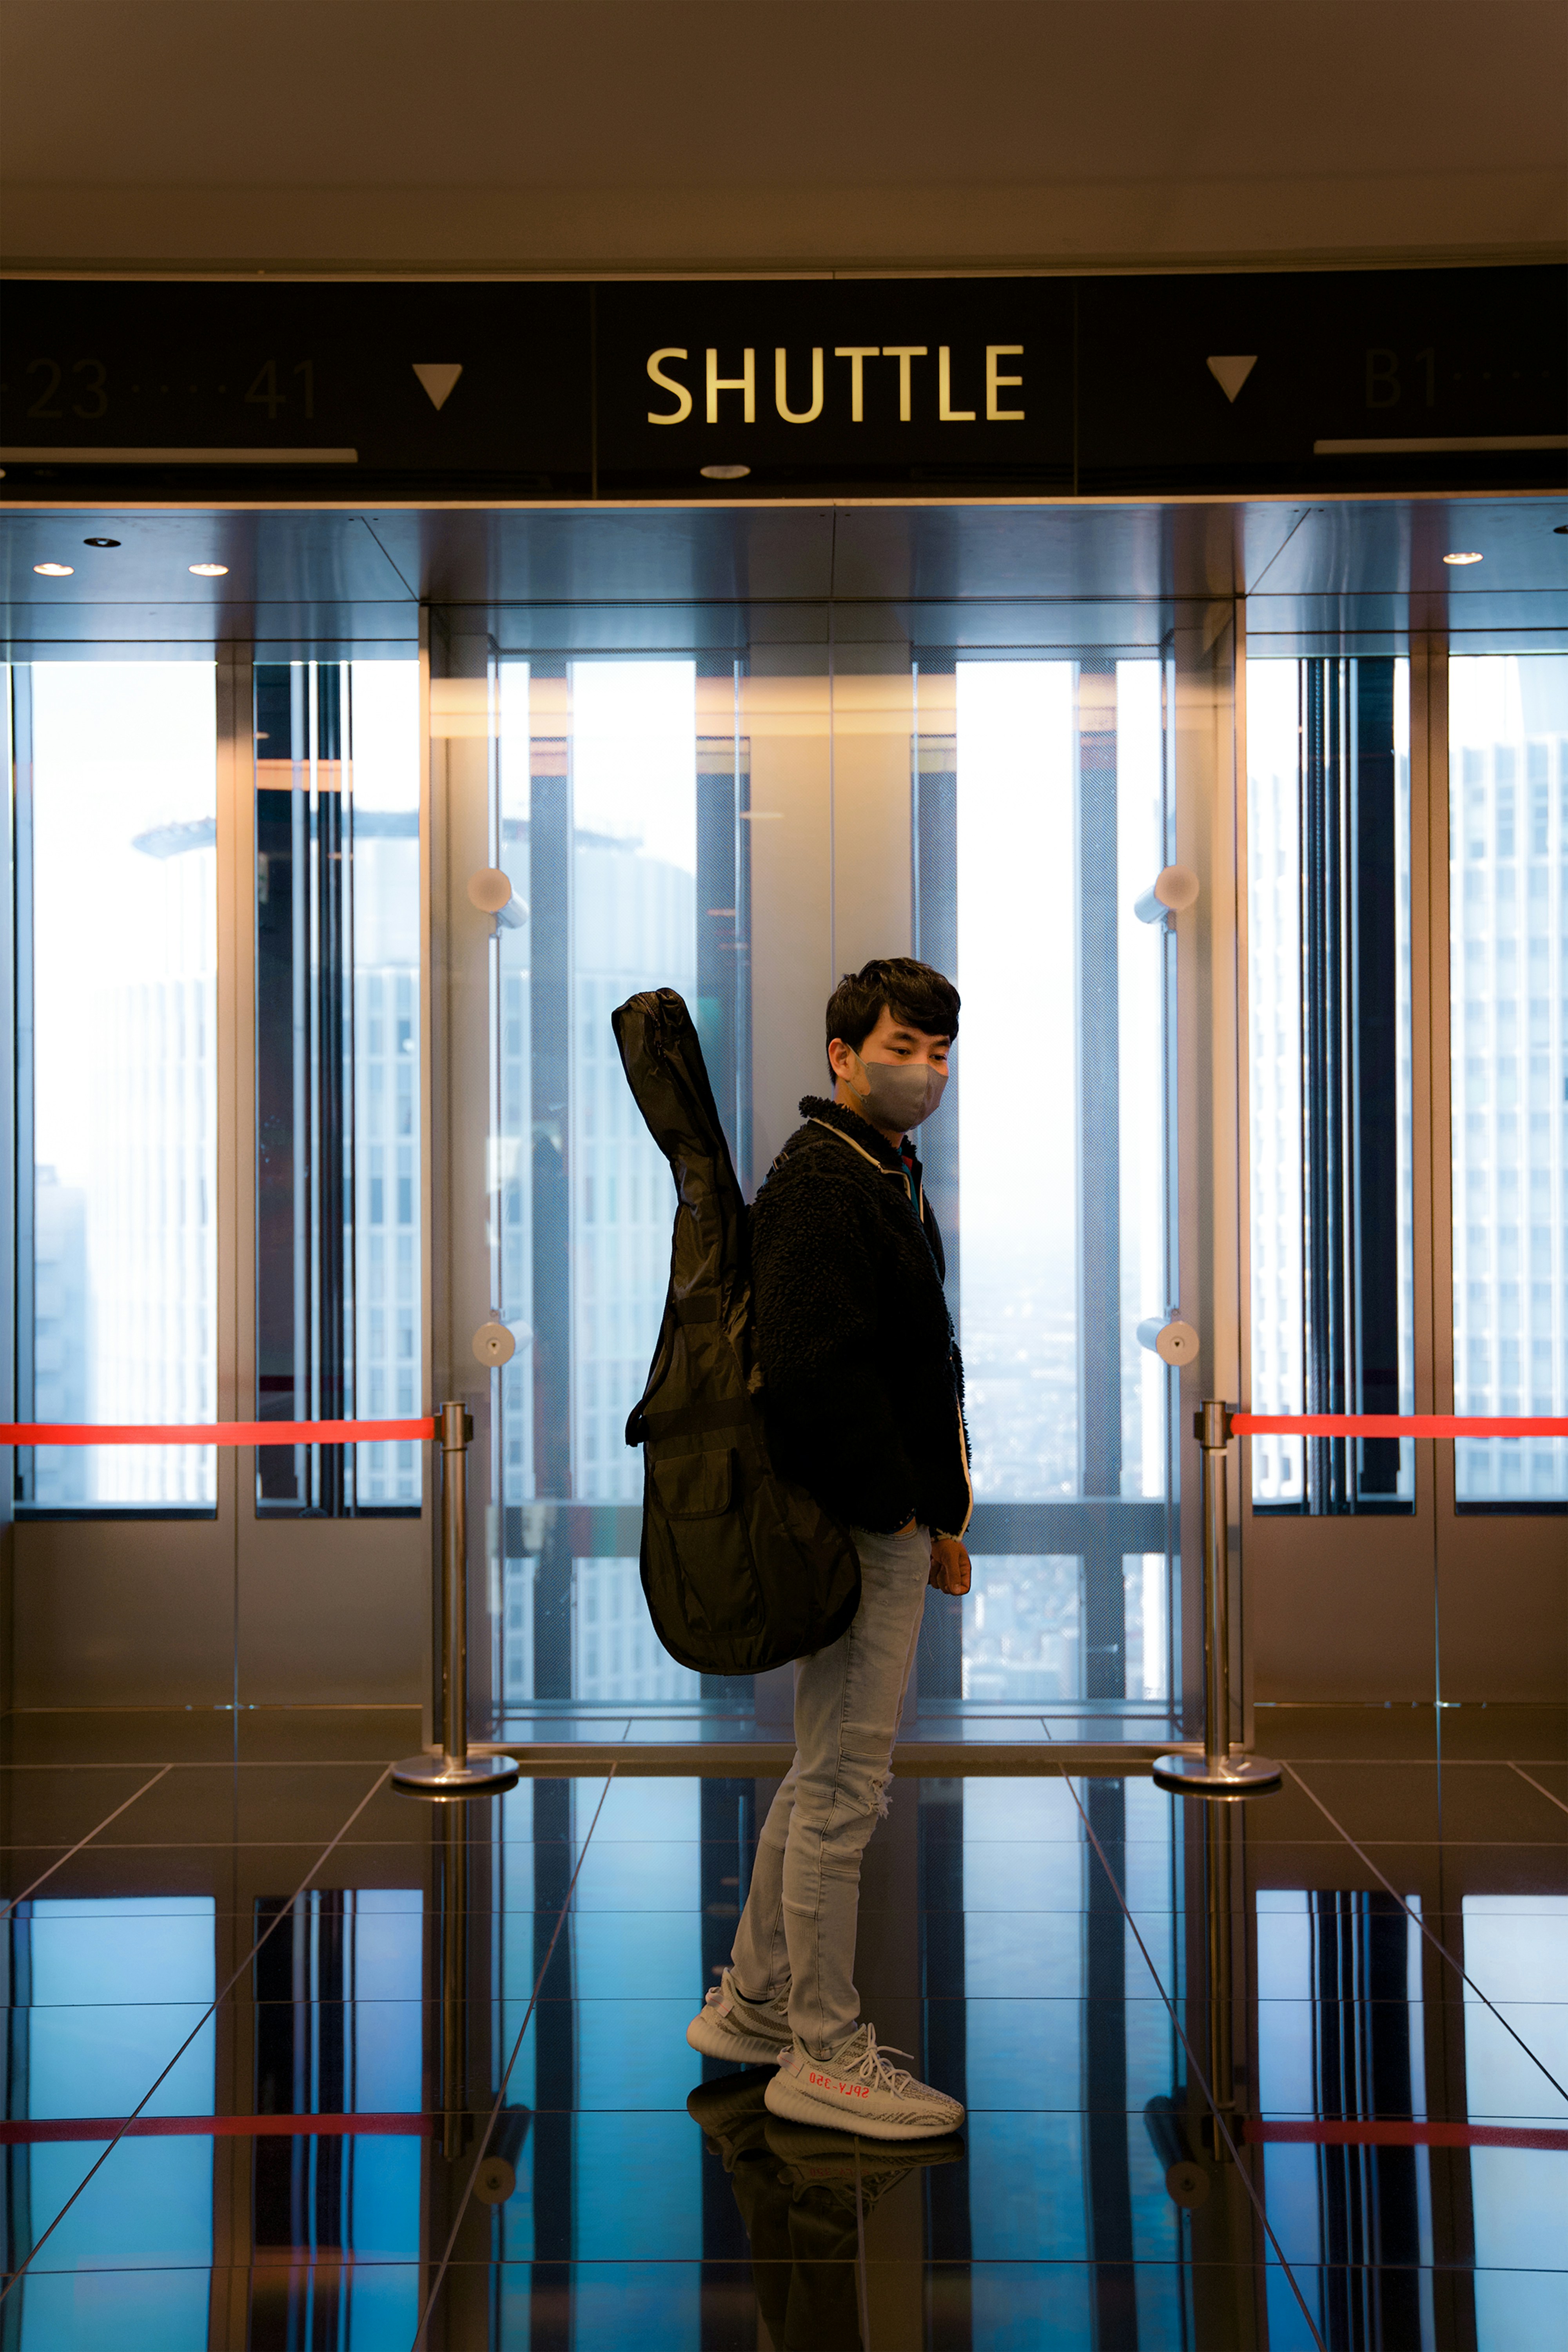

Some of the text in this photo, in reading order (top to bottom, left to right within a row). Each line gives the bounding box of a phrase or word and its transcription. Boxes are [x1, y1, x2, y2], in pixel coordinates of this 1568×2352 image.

[27, 359, 314, 419] 23 41
[646, 345, 1024, 425] SHUTTLE
[1366, 347, 1435, 408] B1
[810, 2168, 871, 2177] SLY-350
